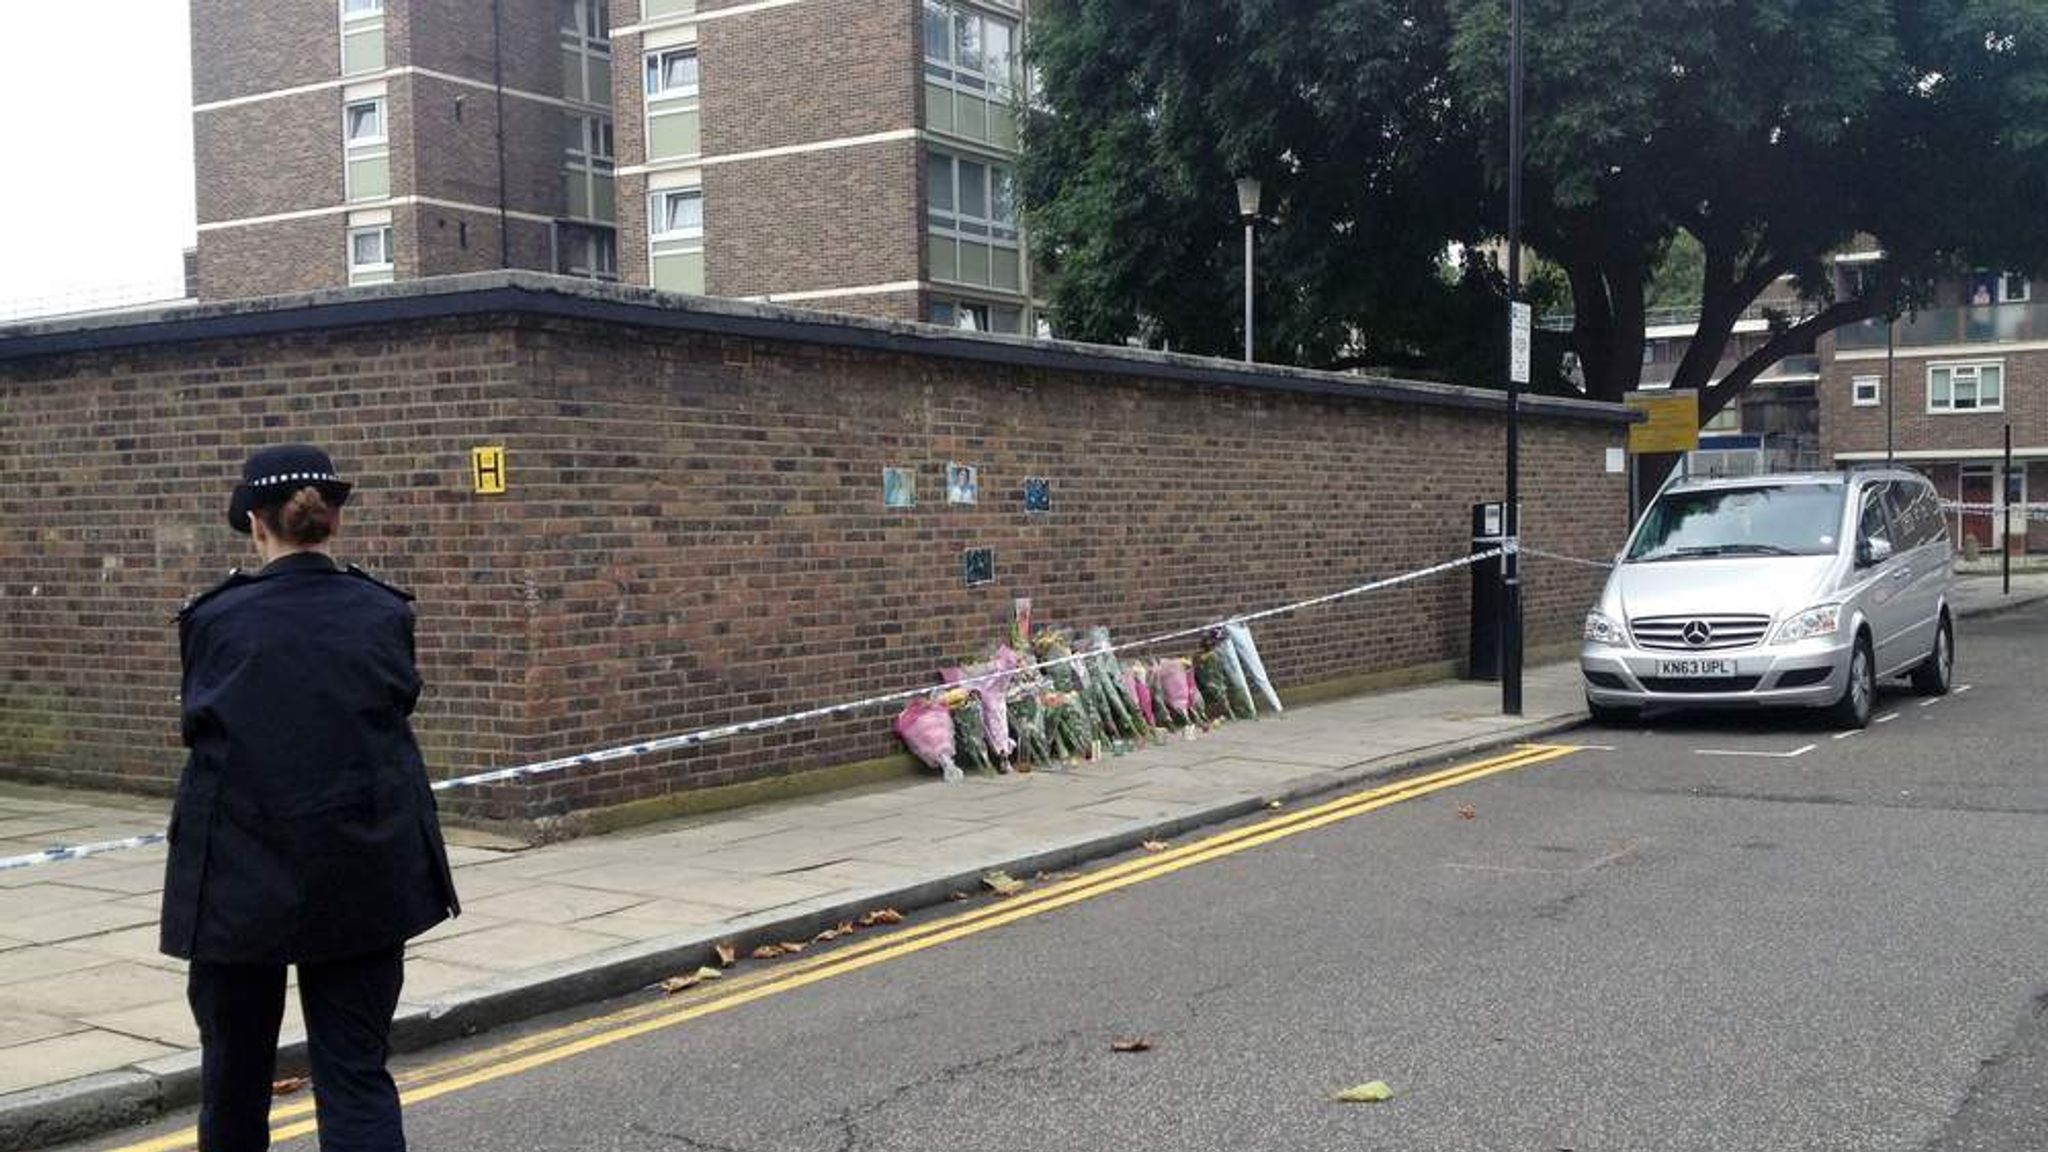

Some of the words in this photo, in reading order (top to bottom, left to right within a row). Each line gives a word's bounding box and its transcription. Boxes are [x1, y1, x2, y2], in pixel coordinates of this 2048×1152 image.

[477, 452, 499, 488] H
[1662, 660, 1699, 674] KN63
[1701, 660, 1729, 673] UPL
